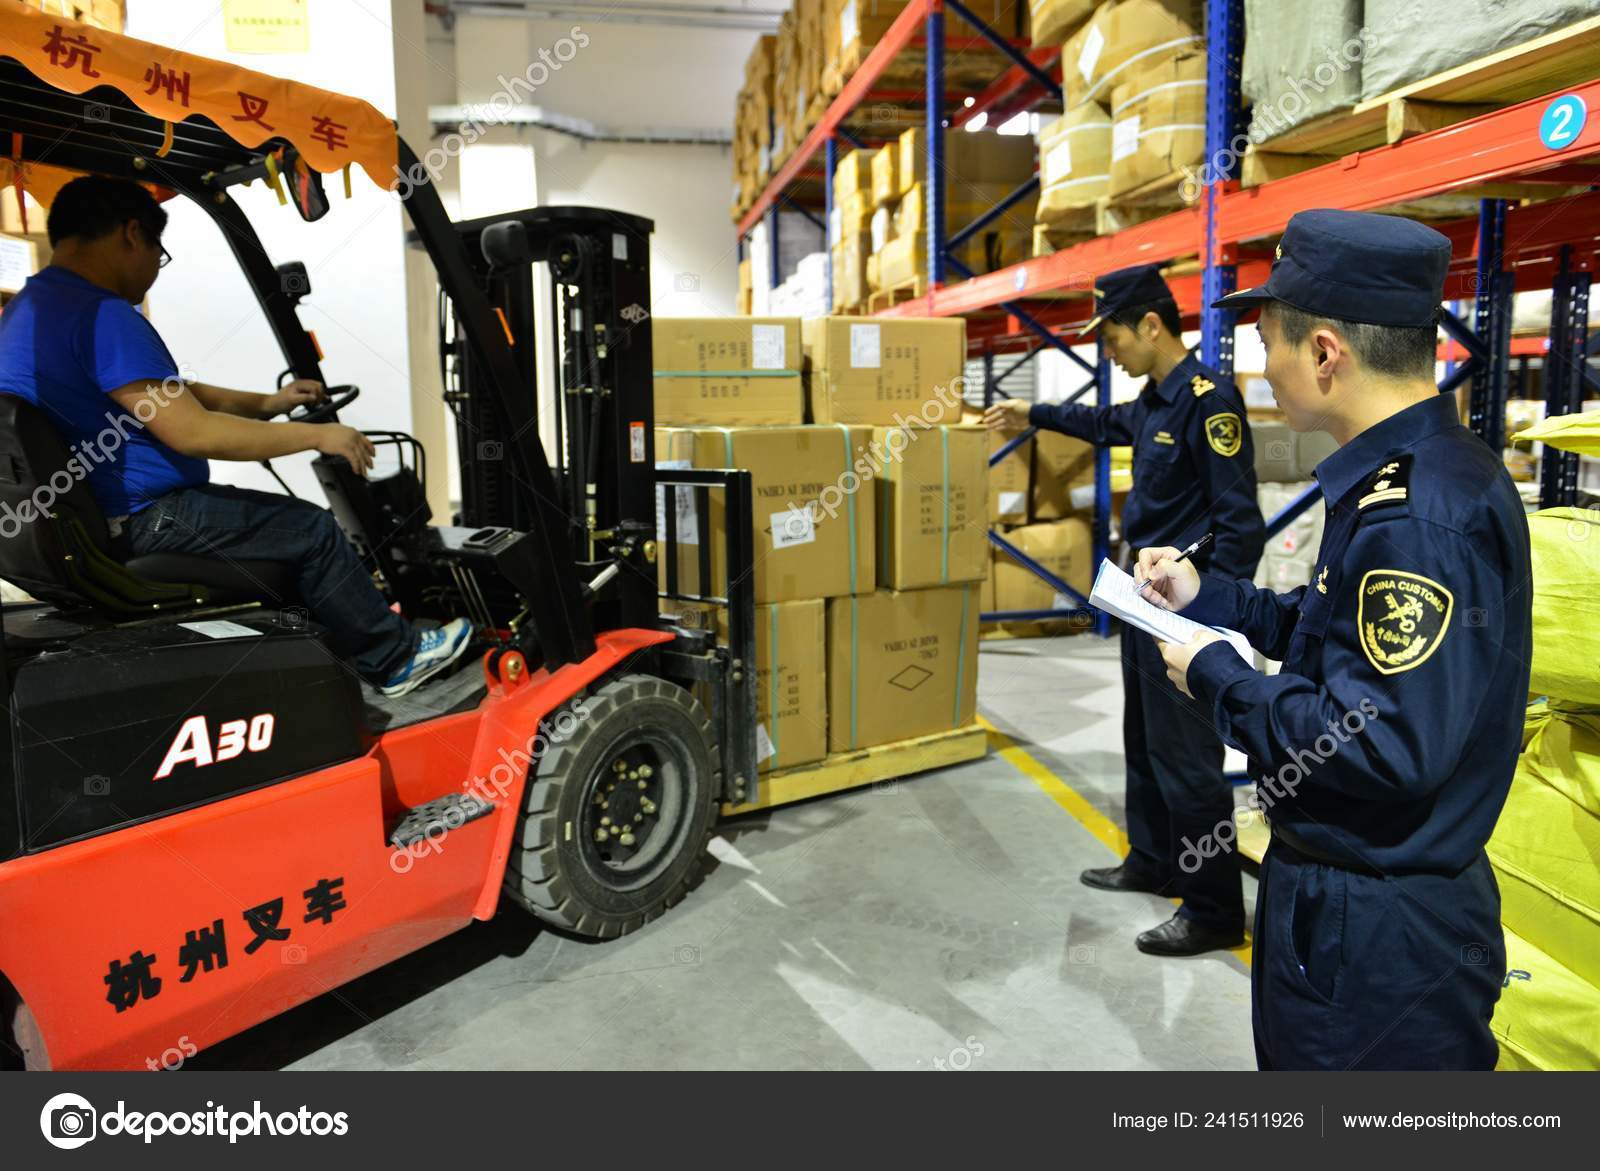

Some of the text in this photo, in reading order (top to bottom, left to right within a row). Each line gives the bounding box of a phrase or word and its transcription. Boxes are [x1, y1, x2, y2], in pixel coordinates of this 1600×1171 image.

[42, 25, 349, 152] 杭州叉车
[1549, 104, 1573, 142] 2
[1366, 580, 1446, 613] CHINA CUSTOMS
[152, 713, 275, 781] A30
[103, 876, 348, 1014] 杭州叉车
